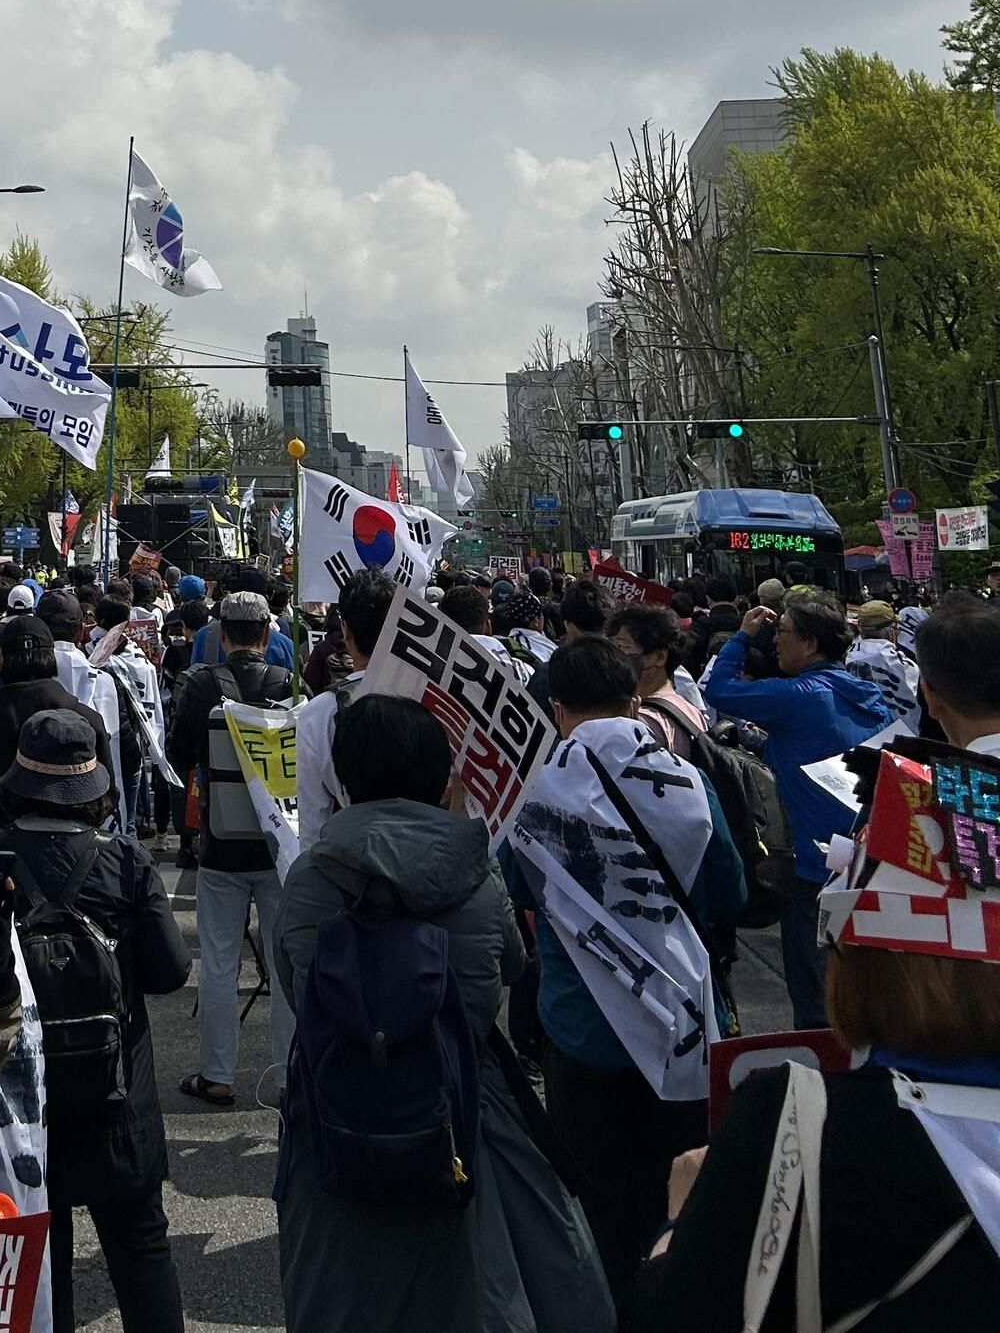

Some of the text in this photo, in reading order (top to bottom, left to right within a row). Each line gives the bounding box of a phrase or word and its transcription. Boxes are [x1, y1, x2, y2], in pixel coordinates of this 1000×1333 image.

[60, 413, 95, 448] 모임
[729, 531, 751, 549] 162
[389, 598, 547, 785] 김건희
[420, 681, 523, 838] 특검!
